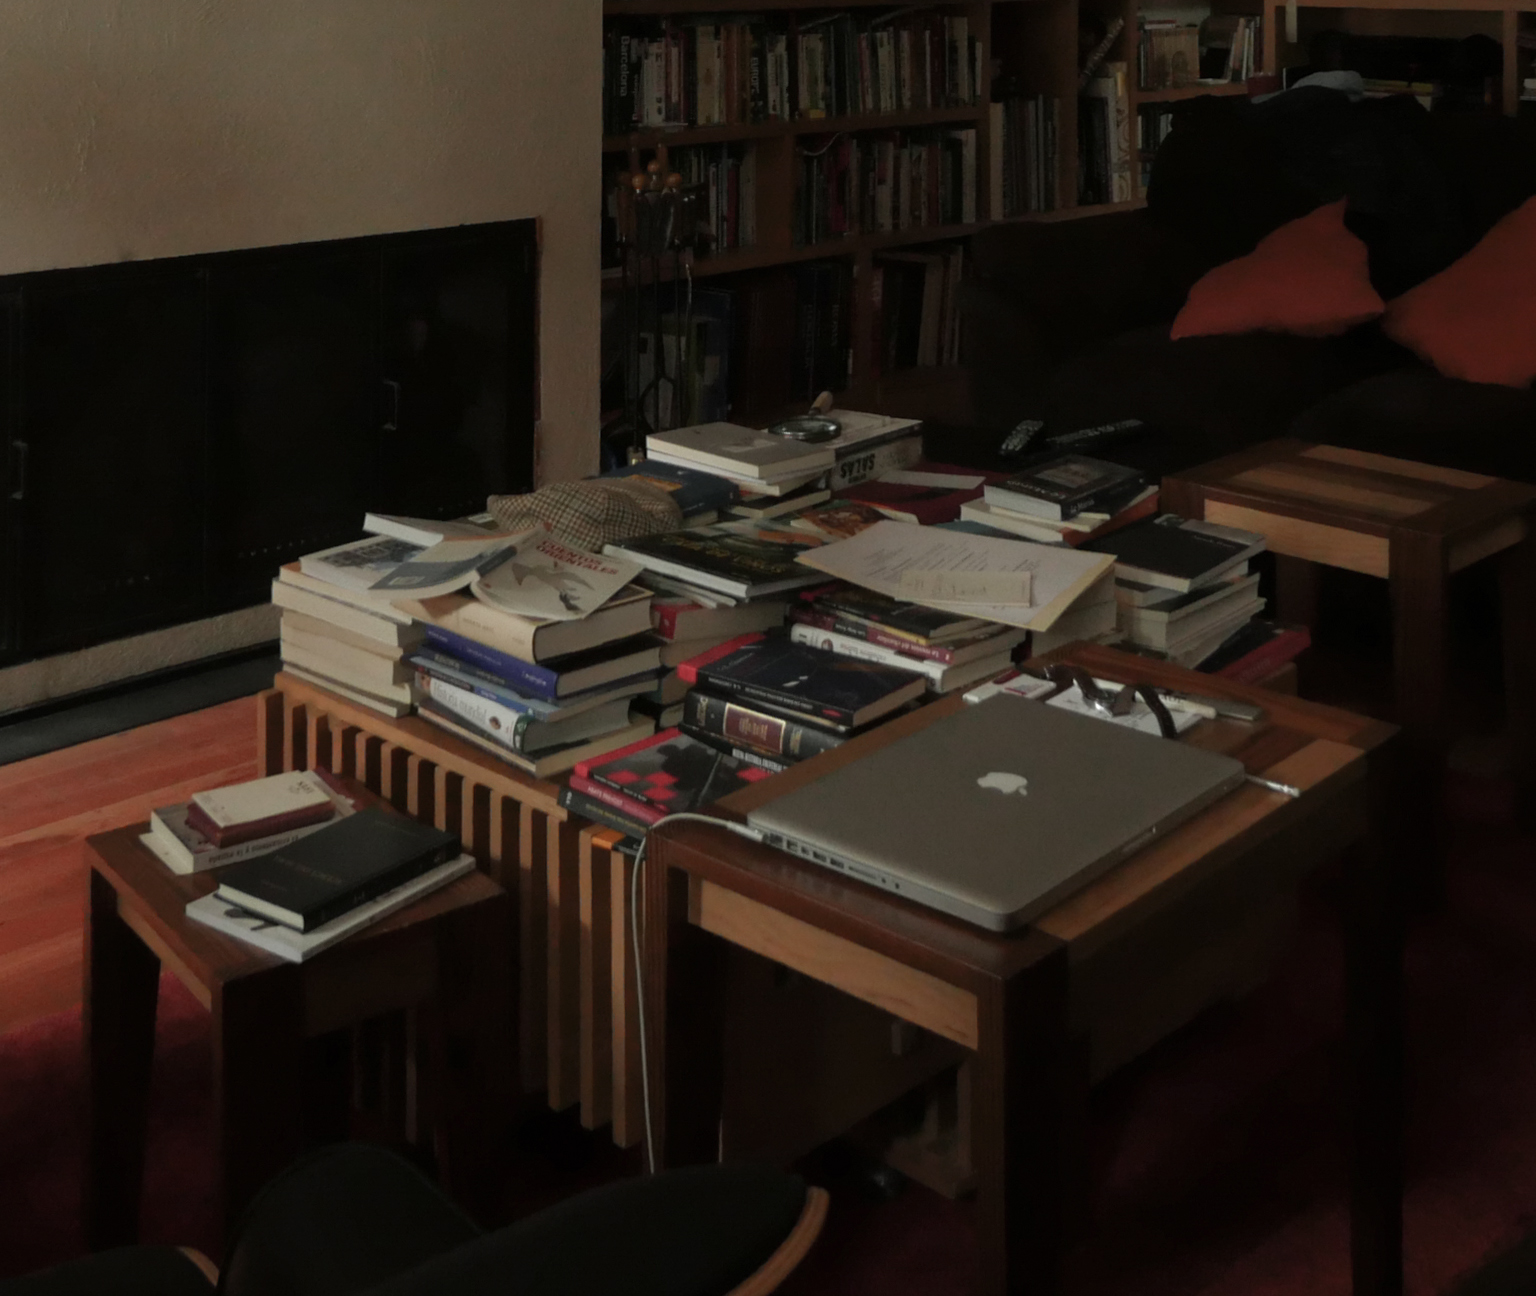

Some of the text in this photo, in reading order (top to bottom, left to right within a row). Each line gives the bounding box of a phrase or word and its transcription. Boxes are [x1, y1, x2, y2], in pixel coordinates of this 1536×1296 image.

[619, 35, 631, 96] Barcelona
[840, 453, 875, 479] SALAS
[536, 545, 619, 576] ORIENTALES
[542, 540, 603, 566] CUENTOS
